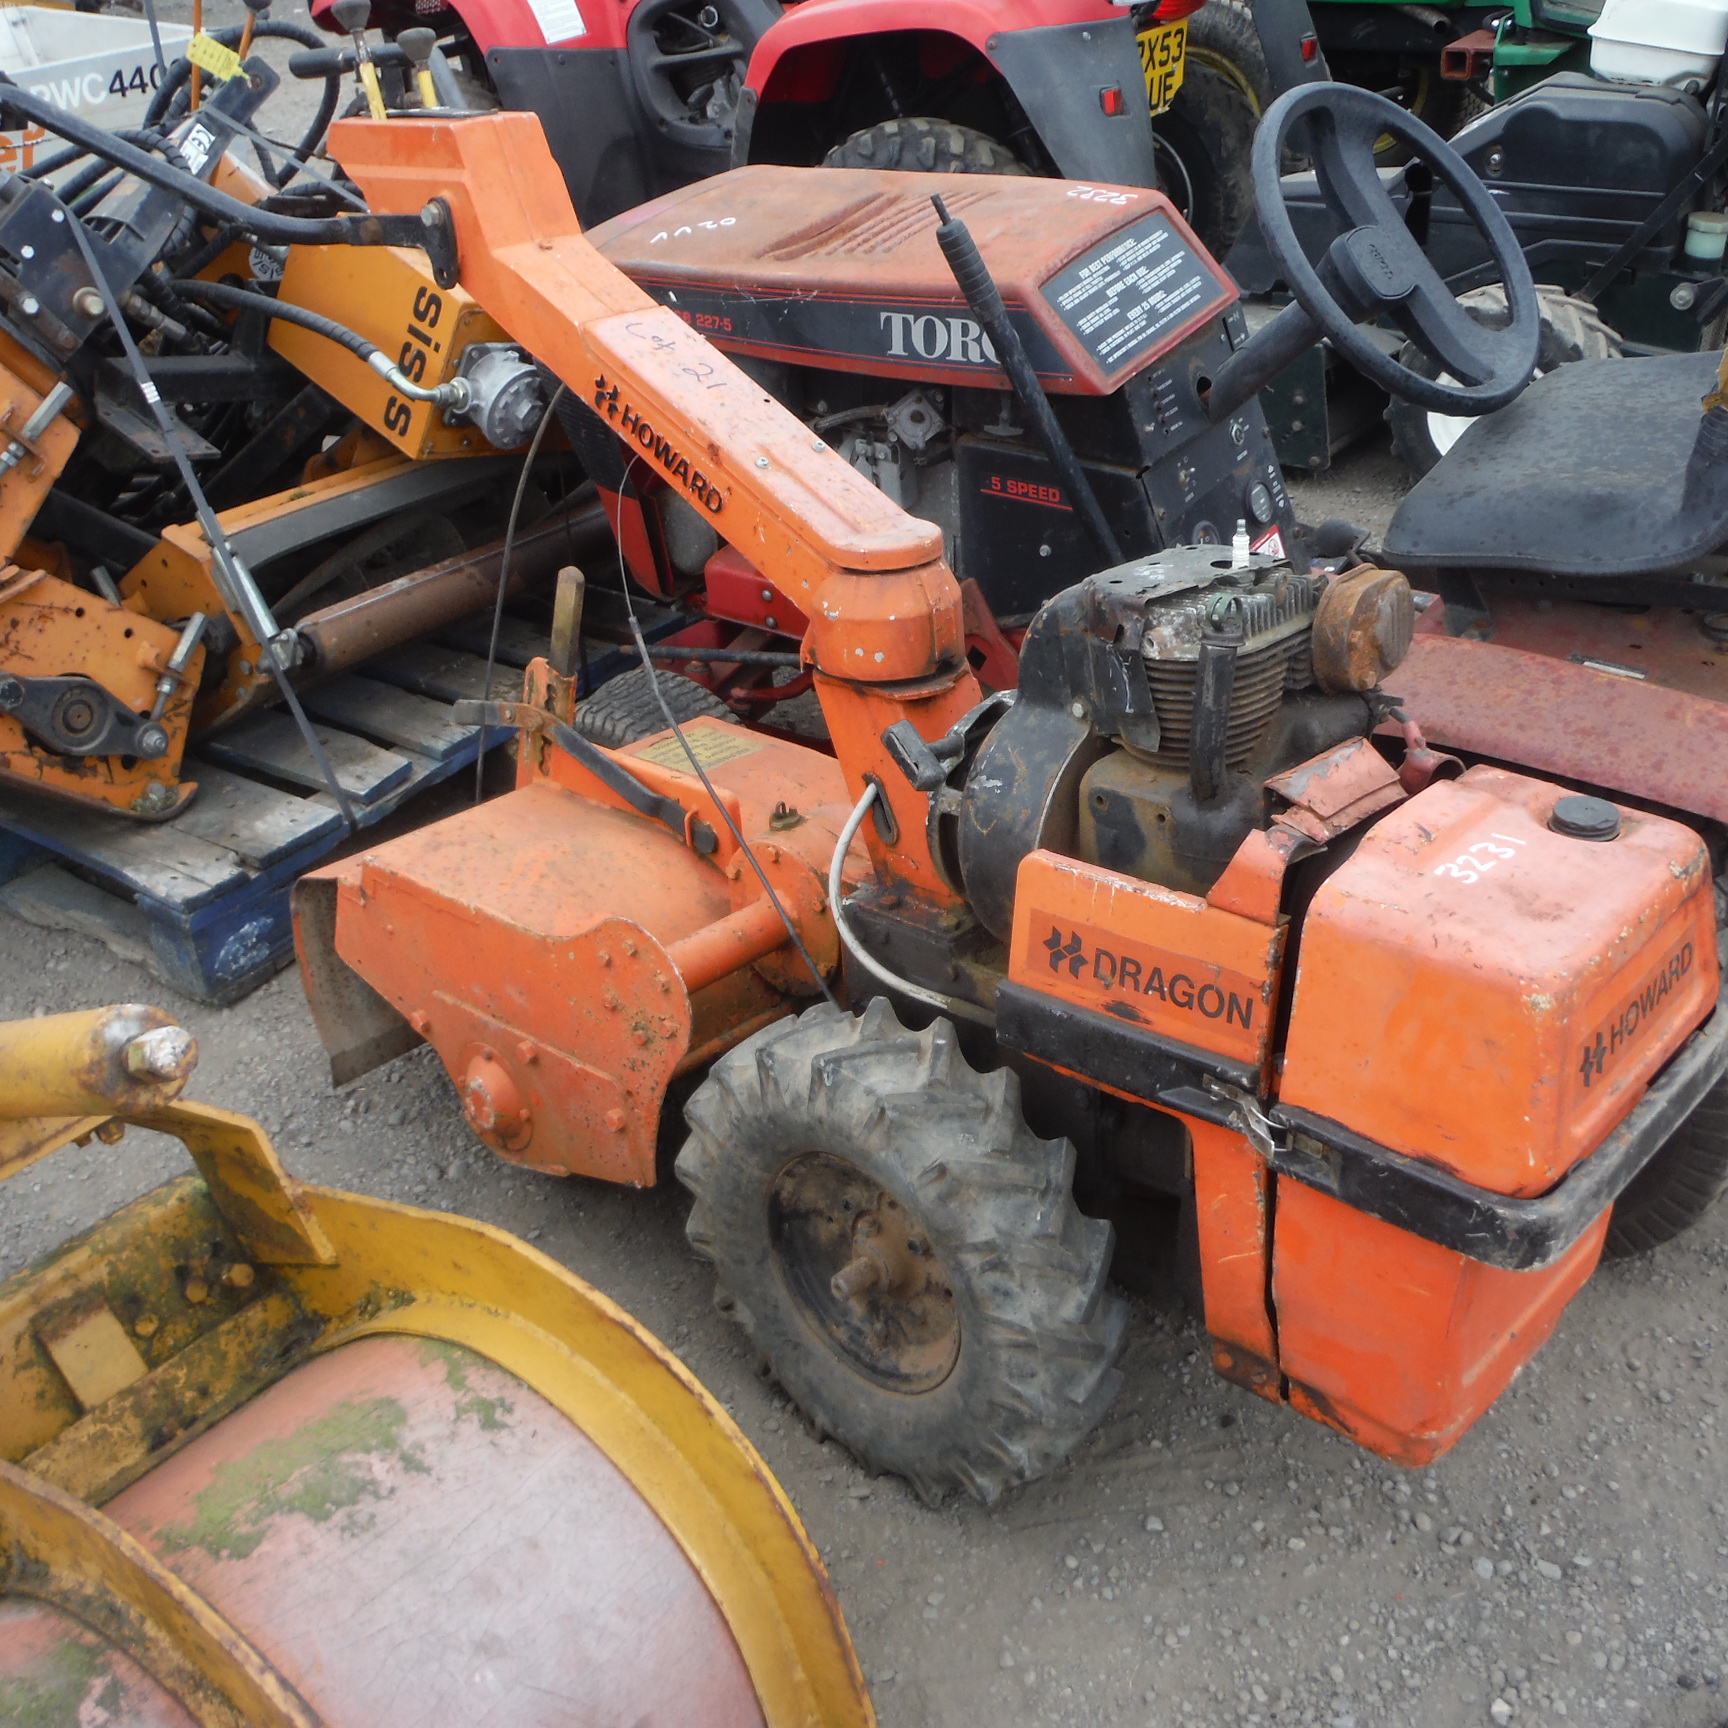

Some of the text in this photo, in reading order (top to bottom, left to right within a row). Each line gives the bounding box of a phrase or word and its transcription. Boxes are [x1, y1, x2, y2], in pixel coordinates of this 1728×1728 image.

[682, 363, 727, 389] 21
[621, 403, 724, 514] HOWARD
[991, 476, 1060, 502] 5 SPEED
[1434, 832, 1526, 884] 3231
[1093, 947, 1253, 1029] DRAGON
[1611, 942, 1693, 1055] HOWARD
